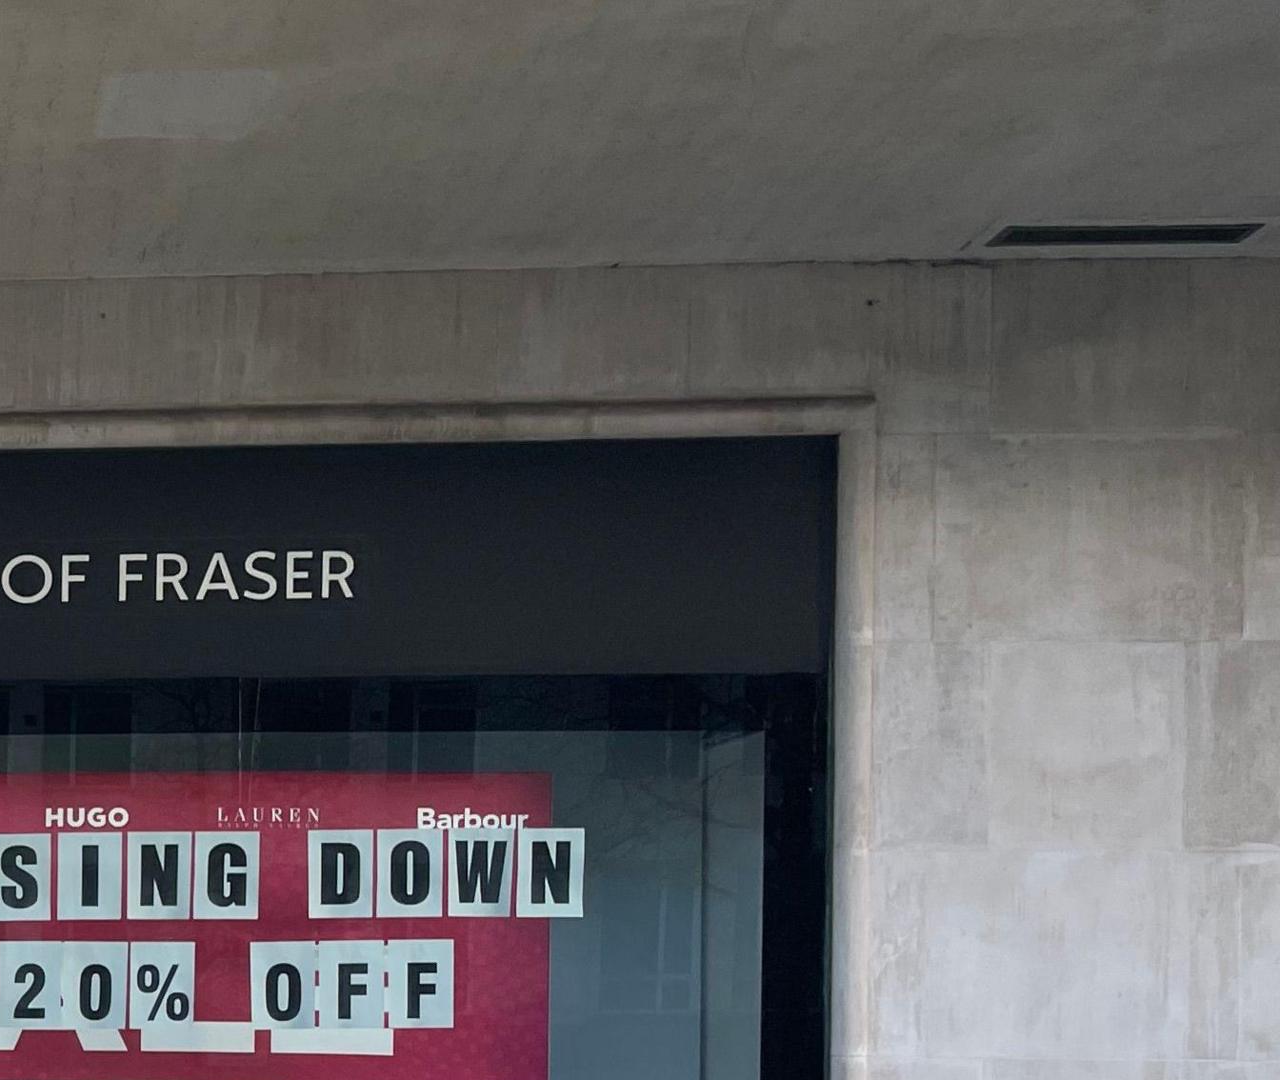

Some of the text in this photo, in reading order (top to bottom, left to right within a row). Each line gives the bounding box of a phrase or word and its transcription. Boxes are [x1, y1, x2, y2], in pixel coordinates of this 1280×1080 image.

[1, 553, 90, 604] OF
[118, 550, 355, 602] FRASER
[45, 807, 129, 828] HUGO
[217, 807, 320, 822] LAUREN
[417, 807, 529, 829] Barbour
[320, 840, 571, 906] DOWN
[13, 963, 190, 1022] 20%
[265, 962, 438, 1022] OFF
